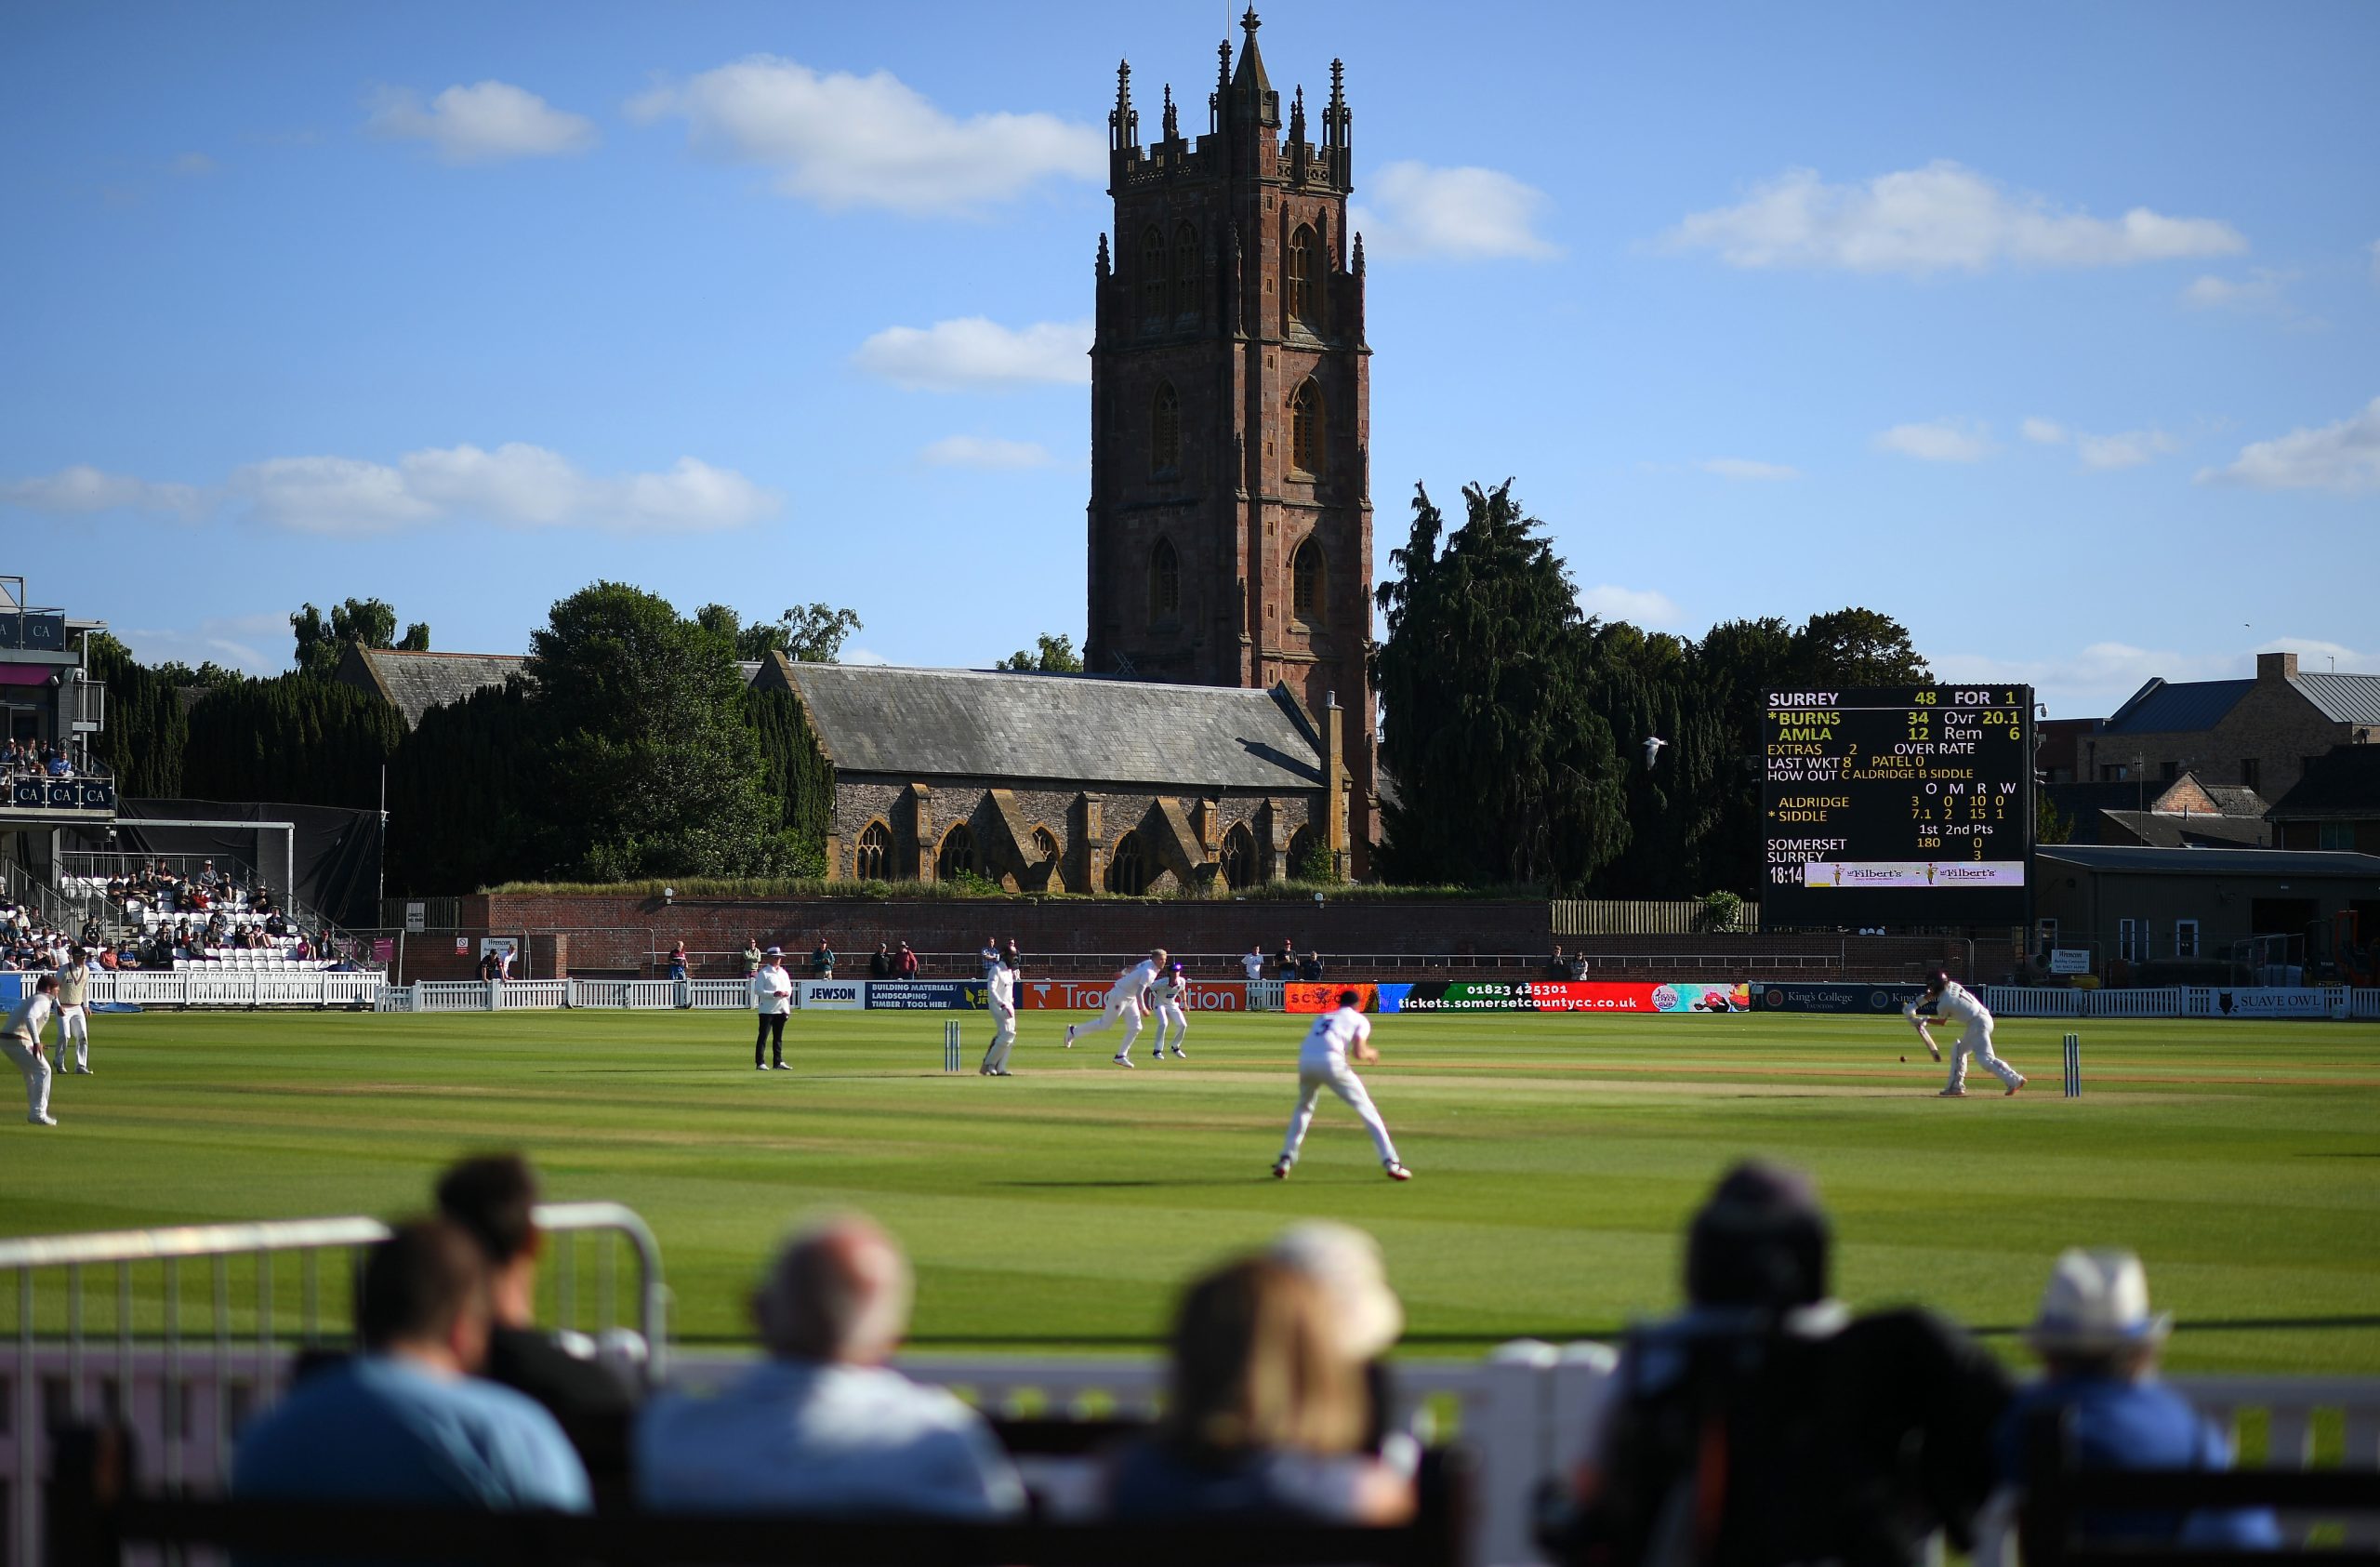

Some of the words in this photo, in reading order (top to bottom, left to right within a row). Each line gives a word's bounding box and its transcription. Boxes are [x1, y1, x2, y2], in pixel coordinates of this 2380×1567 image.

[33, 625, 50, 637] CA
[1769, 693, 1838, 706] SURREY
[1915, 692, 1937, 704] 48
[1955, 692, 1990, 704] FOR
[2005, 692, 2016, 704] 1
[1908, 712, 1929, 724] 34
[1945, 711, 1976, 724] Ovr
[1982, 711, 2019, 724] 20.1
[1778, 728, 1832, 740] AMLA
[1909, 727, 1929, 740] 12
[1945, 727, 1982, 739] Rem
[2010, 727, 2020, 740] 6
[1768, 744, 1822, 755] EXTRAS
[1849, 744, 1858, 755] 2
[1895, 743, 1935, 754] OVER
[1939, 743, 1976, 754] RATE
[1767, 758, 1803, 769] LAST
[1806, 757, 1840, 768] WKT
[1843, 757, 1852, 768] 8
[1872, 756, 1911, 767] PATEL
[1915, 756, 1924, 767] 0
[1767, 770, 1804, 781] HOW
[1807, 770, 1838, 781] OUT
[1842, 770, 1850, 780] C
[1853, 769, 1915, 779] ALDRIDGE
[1919, 769, 1927, 779] B
[1930, 769, 1974, 779] SIDDLE
[20, 788, 38, 801] CA
[1925, 783, 1937, 795] O
[1950, 783, 1964, 794] M
[1977, 783, 1987, 794] R
[2001, 783, 2016, 794] W
[53, 789, 71, 802] CA
[86, 790, 104, 803] CA
[1778, 797, 1850, 807] ALDRIDGE
[1911, 796, 1920, 806] 3
[1944, 796, 1953, 806] 0
[1970, 796, 1987, 806] 10
[1995, 796, 2004, 806] 0
[1779, 811, 1828, 821] SIDDLE
[1911, 809, 1932, 819] 7.1
[1944, 809, 1952, 819] 2
[1970, 809, 1986, 819] 15
[1997, 809, 2004, 819] 1
[1919, 825, 1938, 835] 1st
[1946, 825, 1970, 835] 2nd
[1974, 825, 1993, 835] Pts
[1768, 839, 1847, 850] SOMERSET
[1917, 838, 1941, 848] 180
[1974, 838, 1982, 848] 0
[1767, 852, 1824, 863] SURREY
[1974, 851, 1981, 861] 3
[1770, 867, 1804, 883] 18:14
[809, 988, 856, 1001] JEWSON
[1467, 984, 1511, 996] 01823
[1515, 983, 1568, 996] 425301
[1788, 991, 1816, 1003] King's
[1818, 991, 1853, 1004] College
[1893, 992, 1917, 1003] King'
[2241, 996, 2284, 1006] SUAVE
[2288, 995, 2321, 1006] OWL
[906, 1000, 928, 1008] TOOL
[1398, 997, 1637, 1012] tickets.somersetcountycc.co.uk
